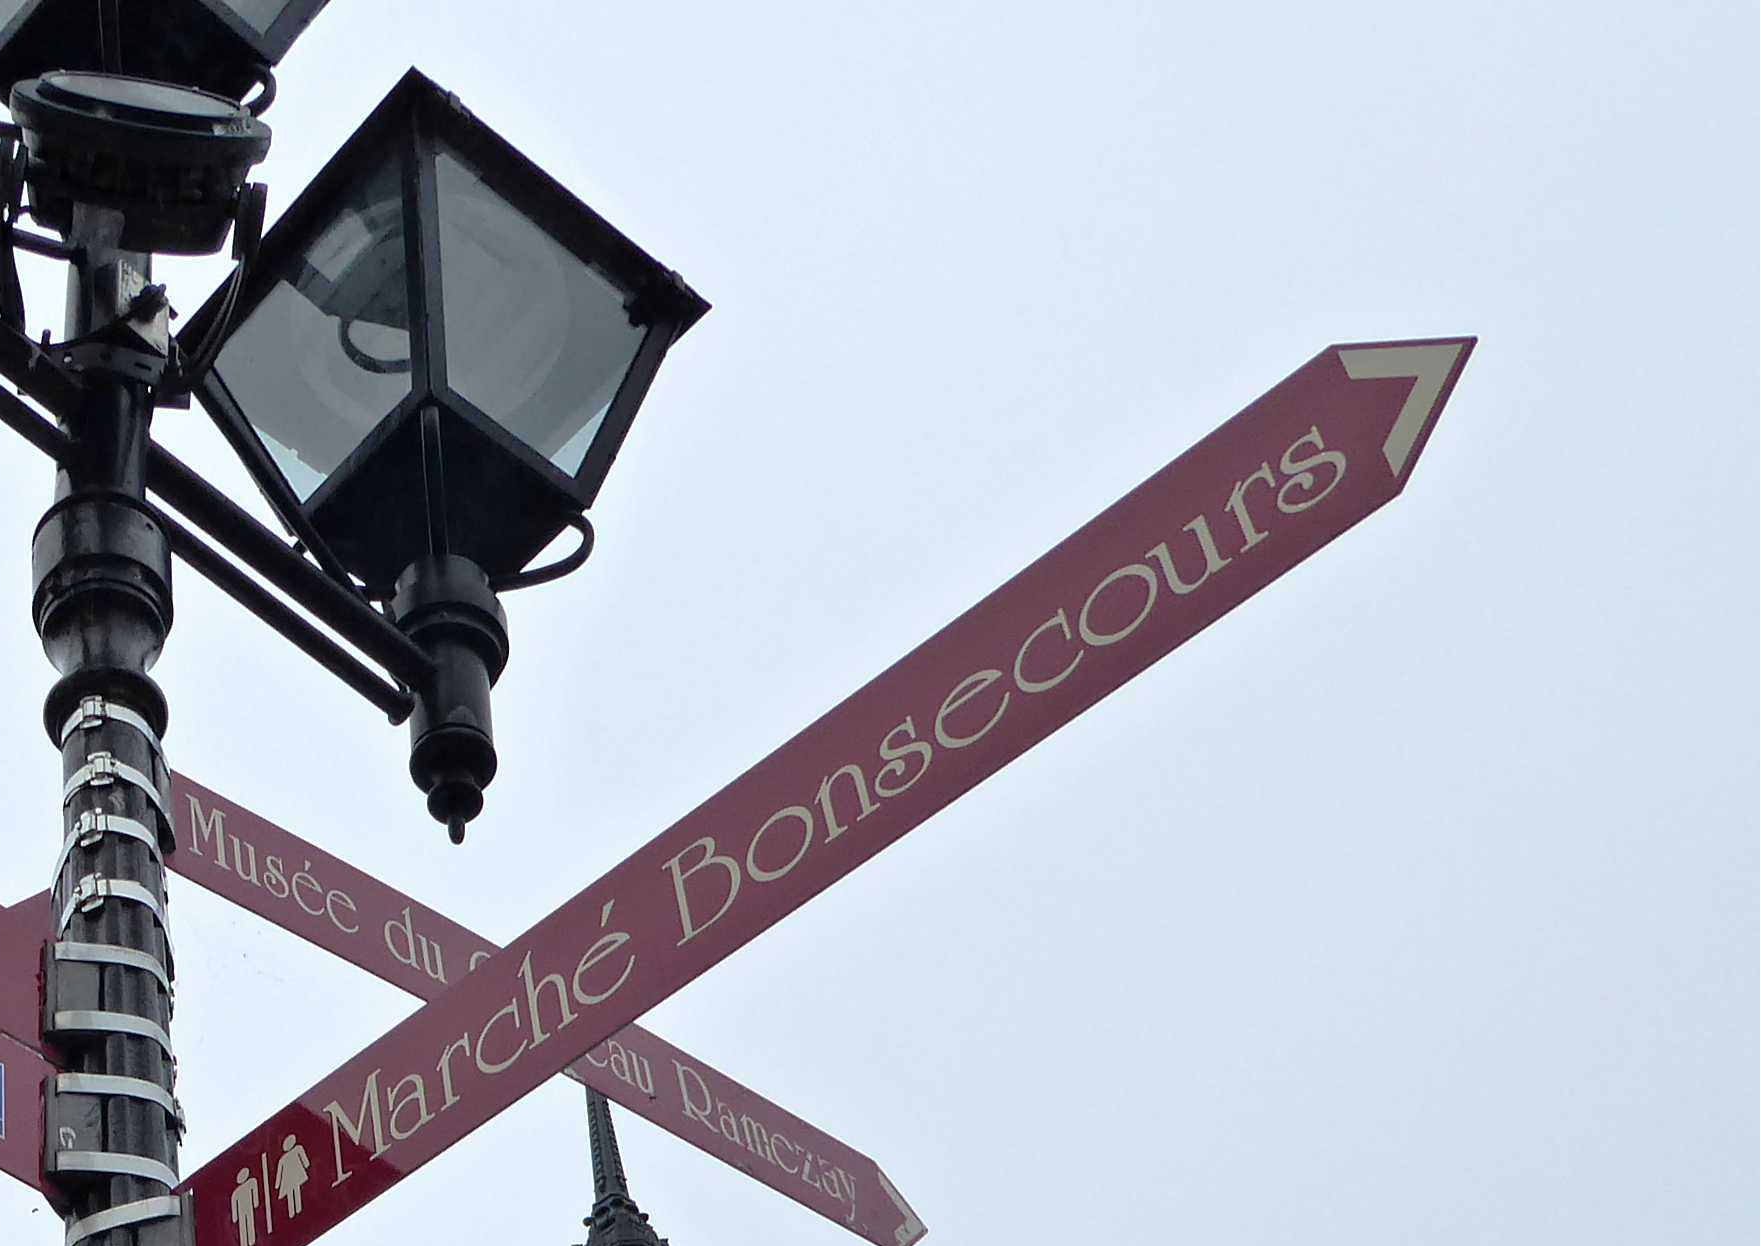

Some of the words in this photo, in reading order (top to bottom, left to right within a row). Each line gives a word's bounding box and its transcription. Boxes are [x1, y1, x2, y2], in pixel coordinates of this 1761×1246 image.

[185, 793, 360, 934] Musée
[384, 906, 449, 984] du
[322, 899, 635, 1187] Marché
[662, 425, 1347, 946] Bonsecours
